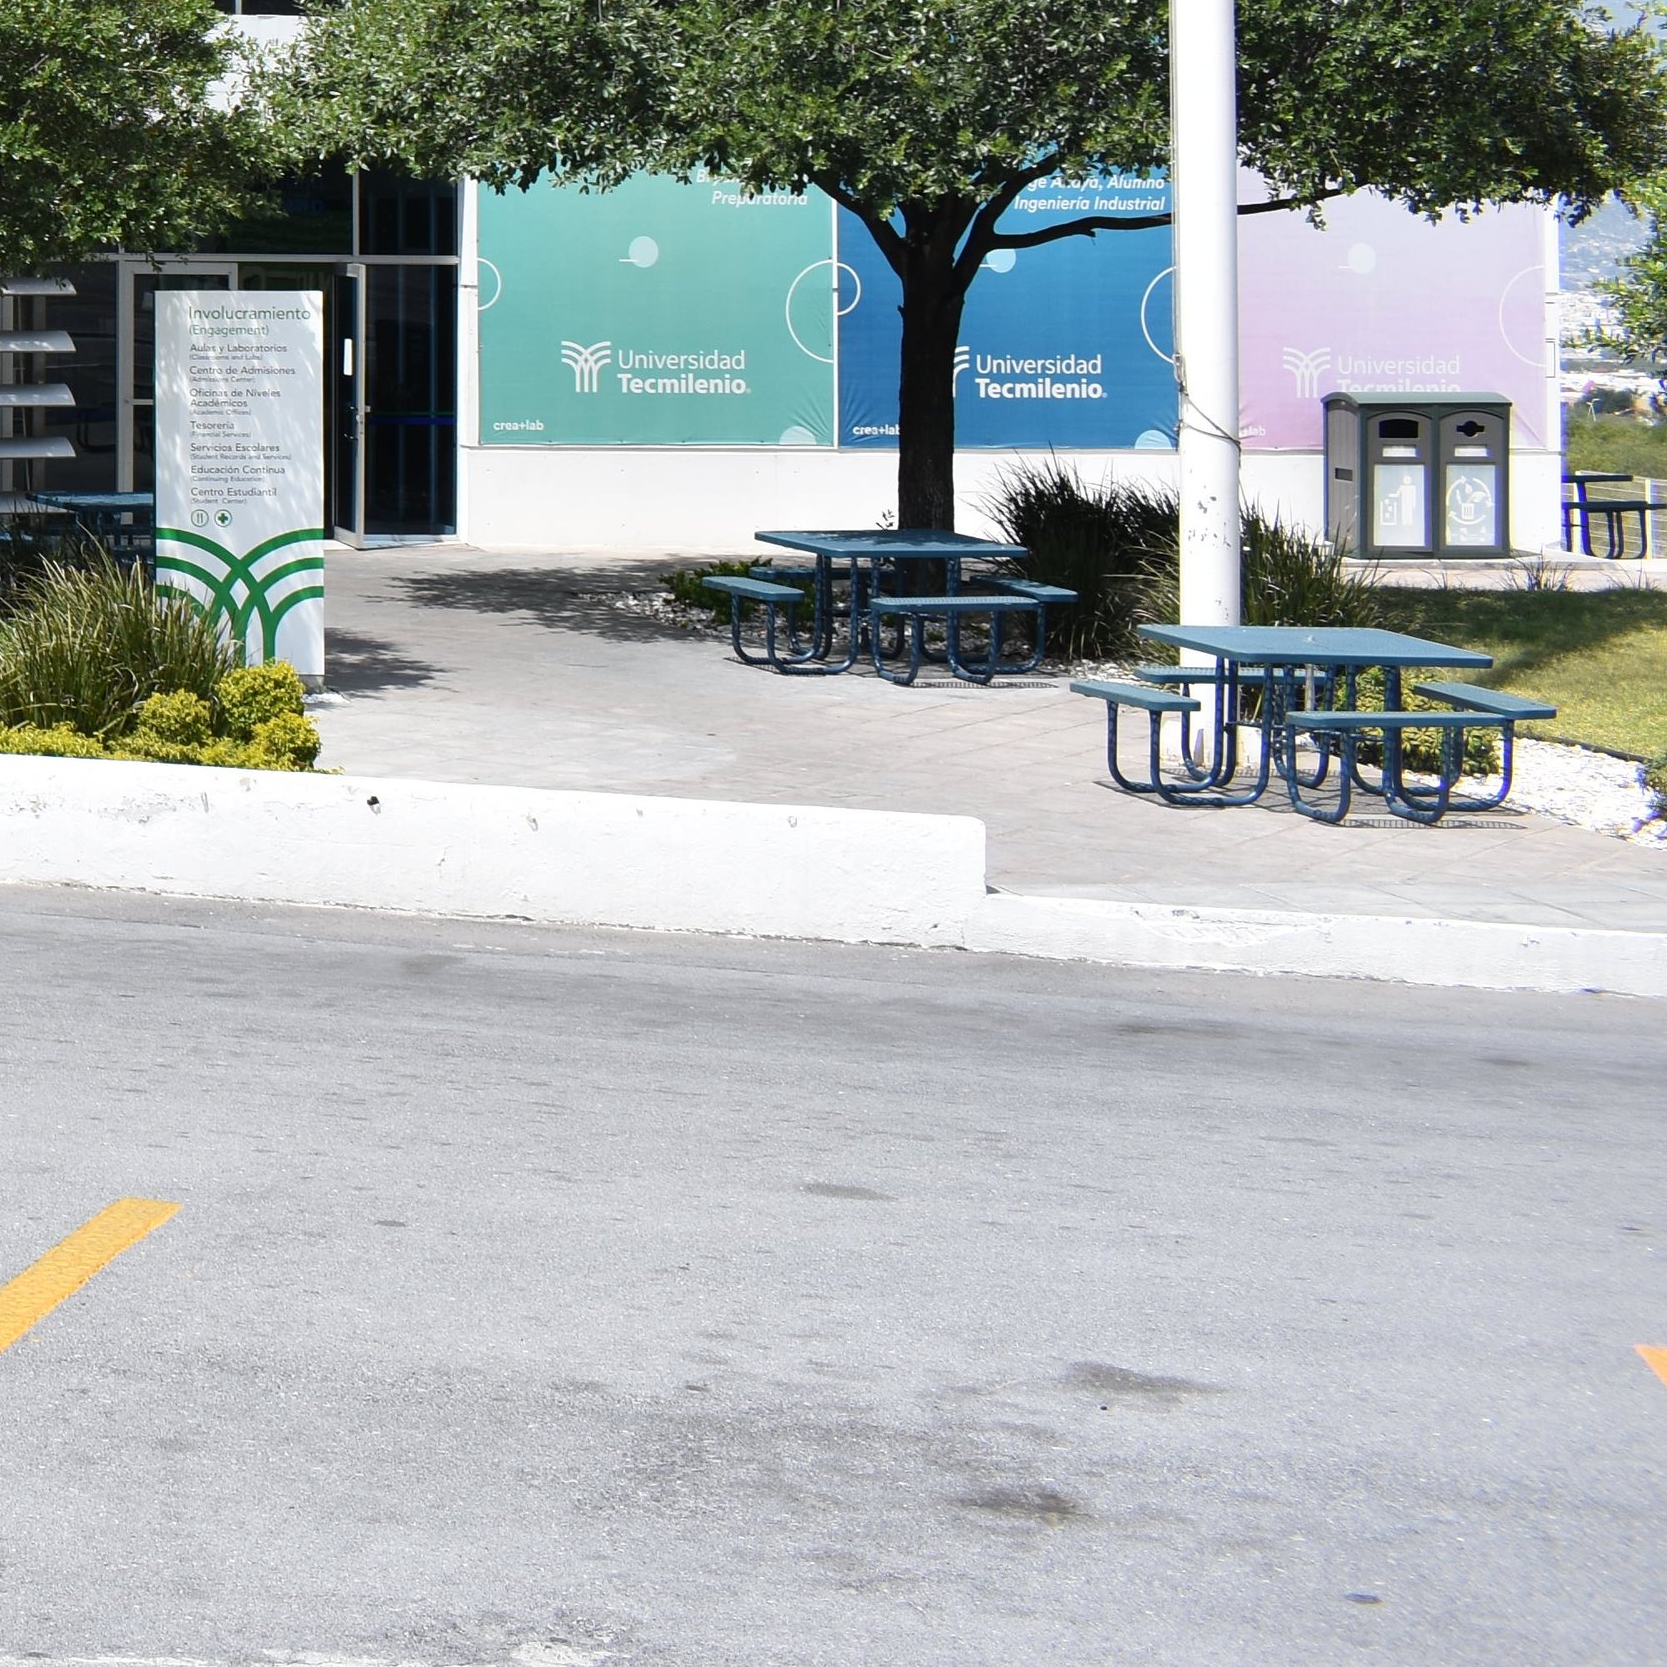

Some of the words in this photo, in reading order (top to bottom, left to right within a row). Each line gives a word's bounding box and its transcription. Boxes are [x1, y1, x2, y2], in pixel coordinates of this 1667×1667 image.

[1014, 195, 1090, 213] Ingeniería
[1094, 195, 1166, 211] Industrial
[189, 305, 311, 320] Involucramiento
[189, 325, 270, 338] (Engagement)
[618, 350, 746, 370] Universidad
[976, 354, 1102, 374] Universidad
[1338, 355, 1460, 375] Universidad
[617, 373, 747, 394] Tecmilenio
[975, 378, 1103, 399] Tecmilenio
[493, 419, 545, 431] crea+lab
